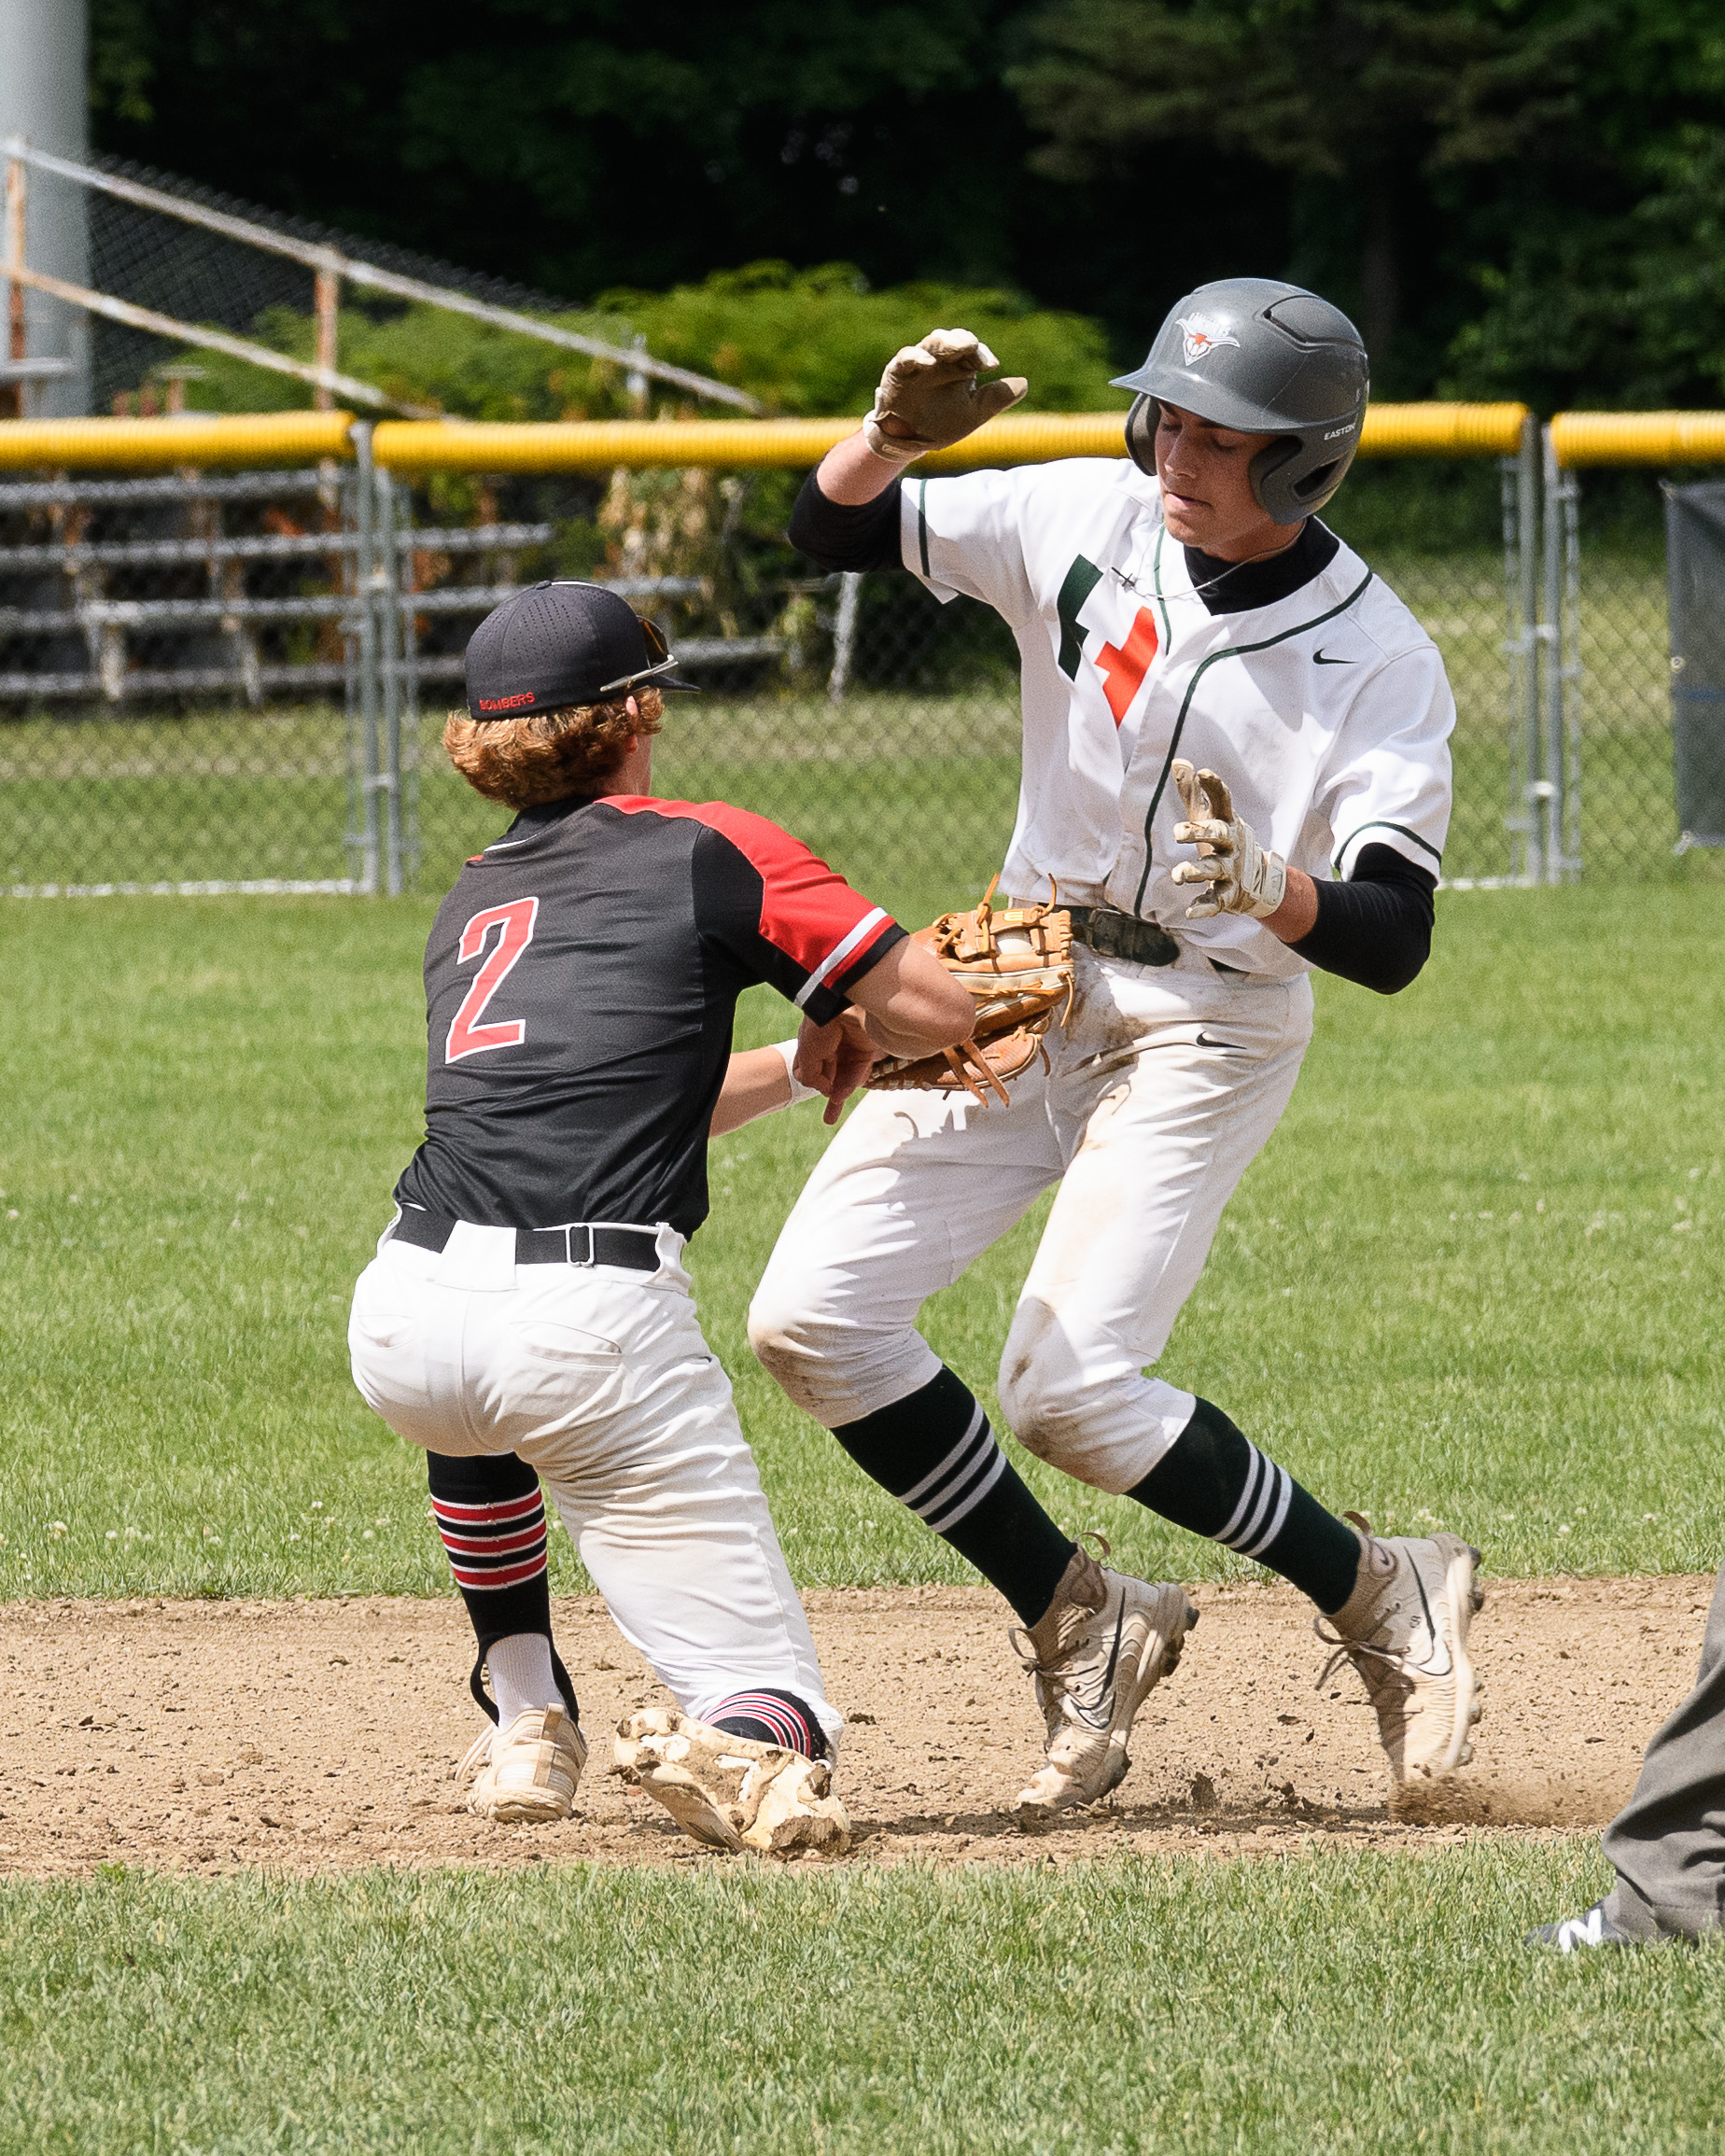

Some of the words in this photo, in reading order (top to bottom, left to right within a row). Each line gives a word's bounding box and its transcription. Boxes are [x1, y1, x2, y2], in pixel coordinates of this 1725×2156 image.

[1324, 422, 1356, 441] EASTON
[479, 692, 536, 710] BOMBERS
[444, 896, 540, 1065] 2
